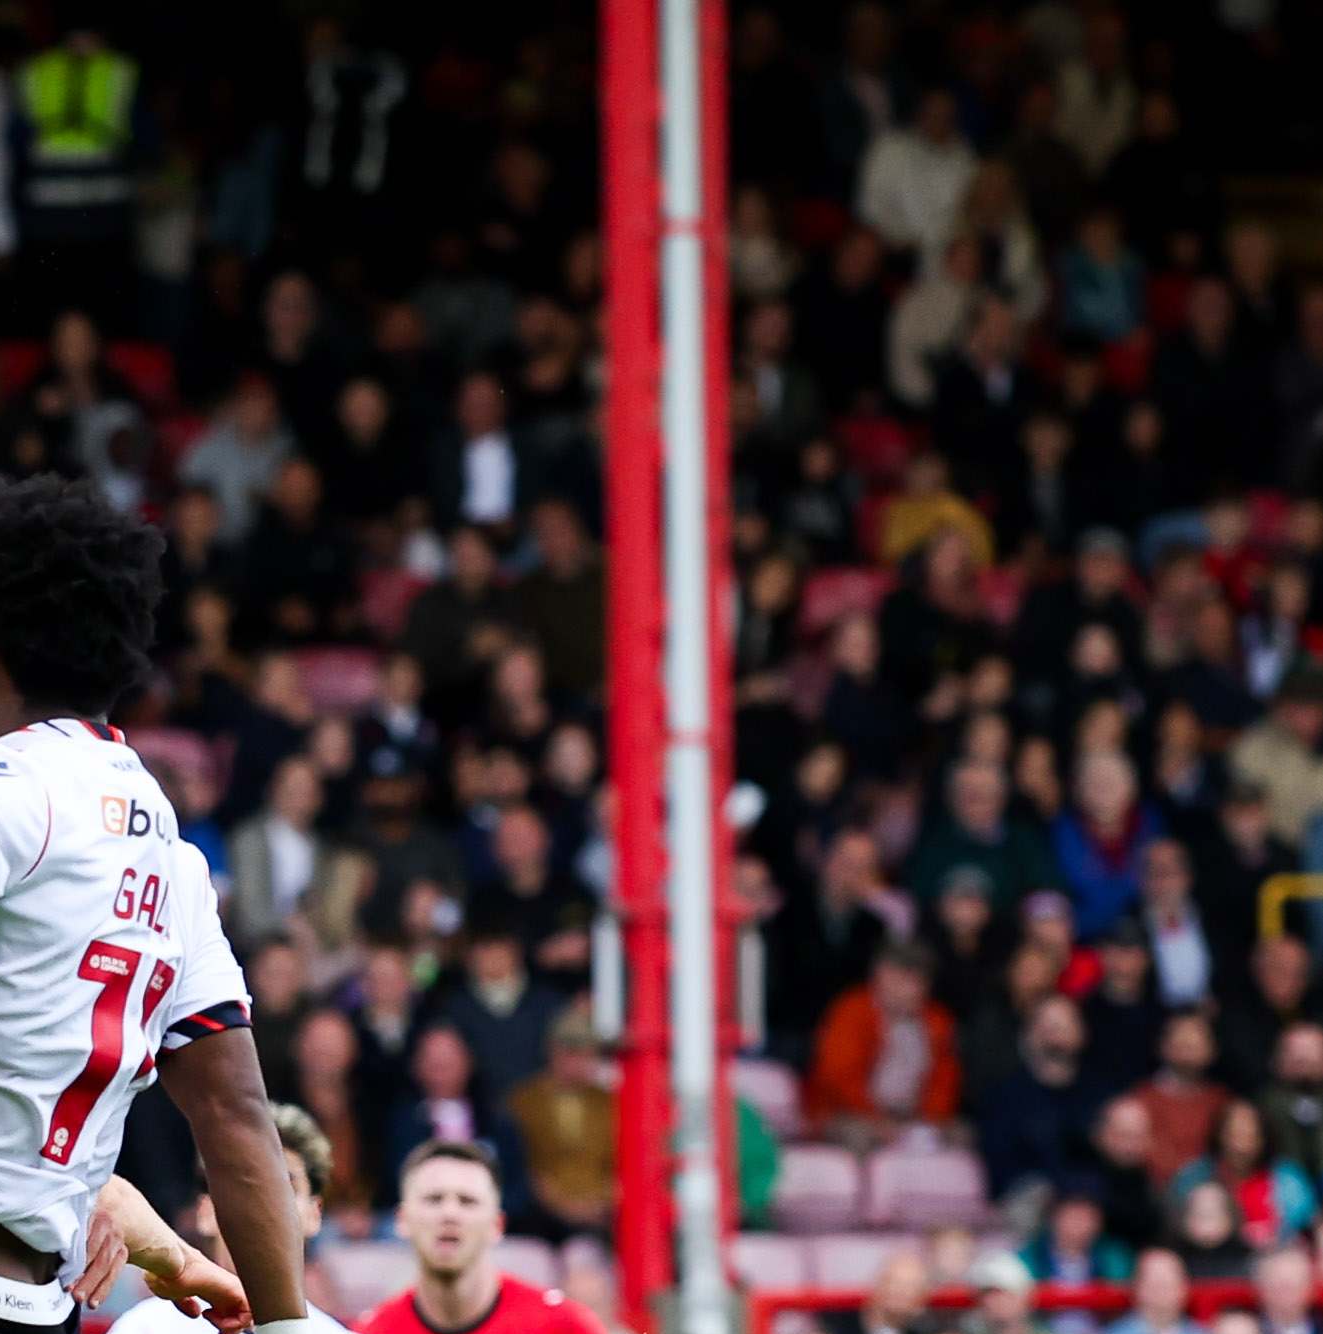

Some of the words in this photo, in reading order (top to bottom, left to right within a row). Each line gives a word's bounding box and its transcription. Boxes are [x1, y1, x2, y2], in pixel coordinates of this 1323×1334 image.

[102, 796, 172, 846] ebu
[114, 868, 170, 941] GAL
[5, 1293, 35, 1311] Klein
